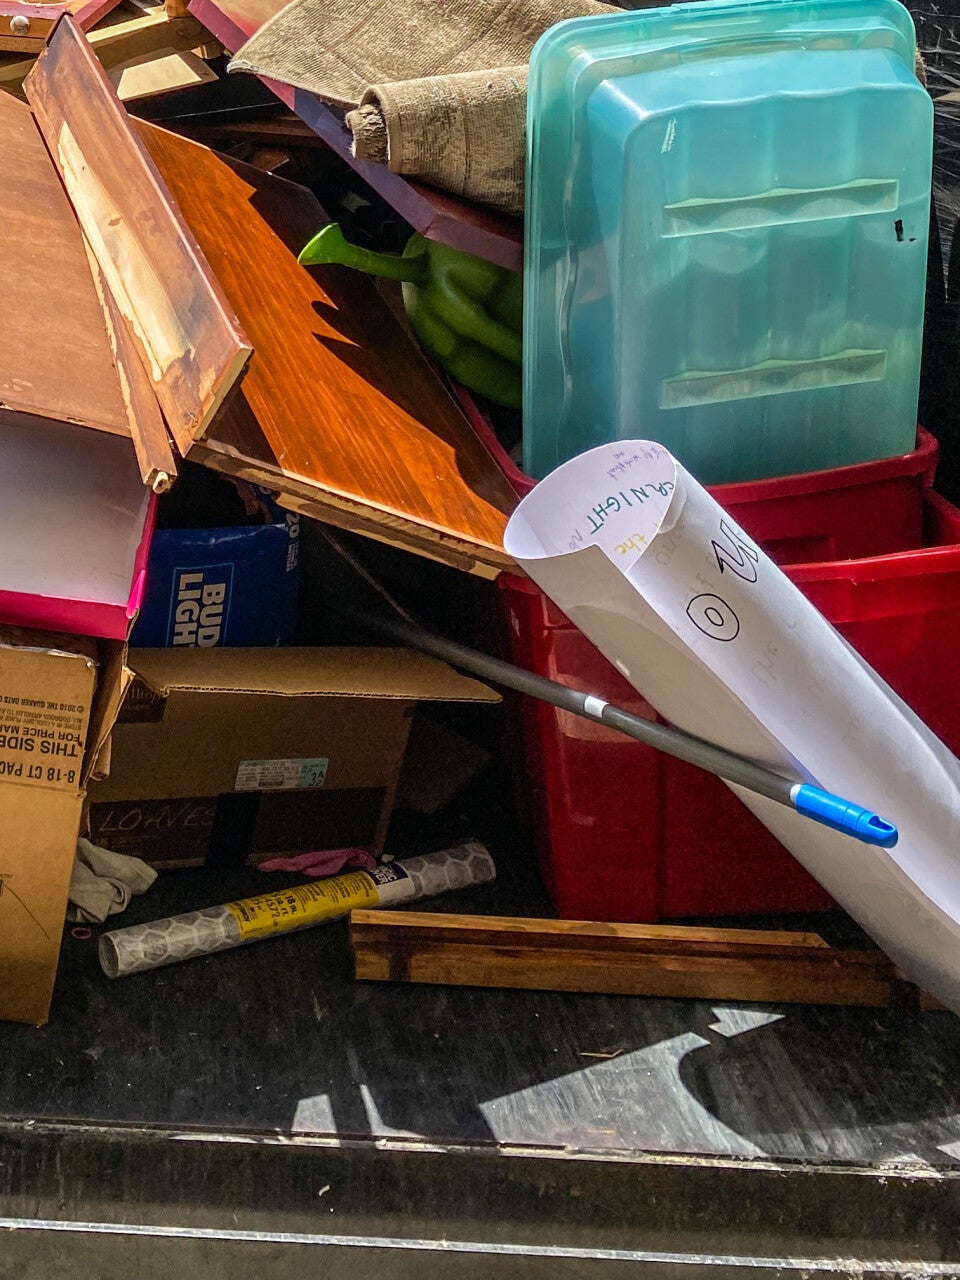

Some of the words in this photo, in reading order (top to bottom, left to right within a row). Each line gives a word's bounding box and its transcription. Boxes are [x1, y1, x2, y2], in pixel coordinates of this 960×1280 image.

[613, 532, 647, 556] the
[173, 573, 204, 647] LIGH
[197, 583, 226, 647] BUD
[4, 696, 20, 705] OATS
[21, 698, 45, 708] QUAKER
[23, 726, 55, 740] PRICE
[58, 730, 80, 743] FOR
[40, 740, 78, 757] THIS
[26, 764, 43, 779] CT
[47, 767, 76, 784] 8-18
